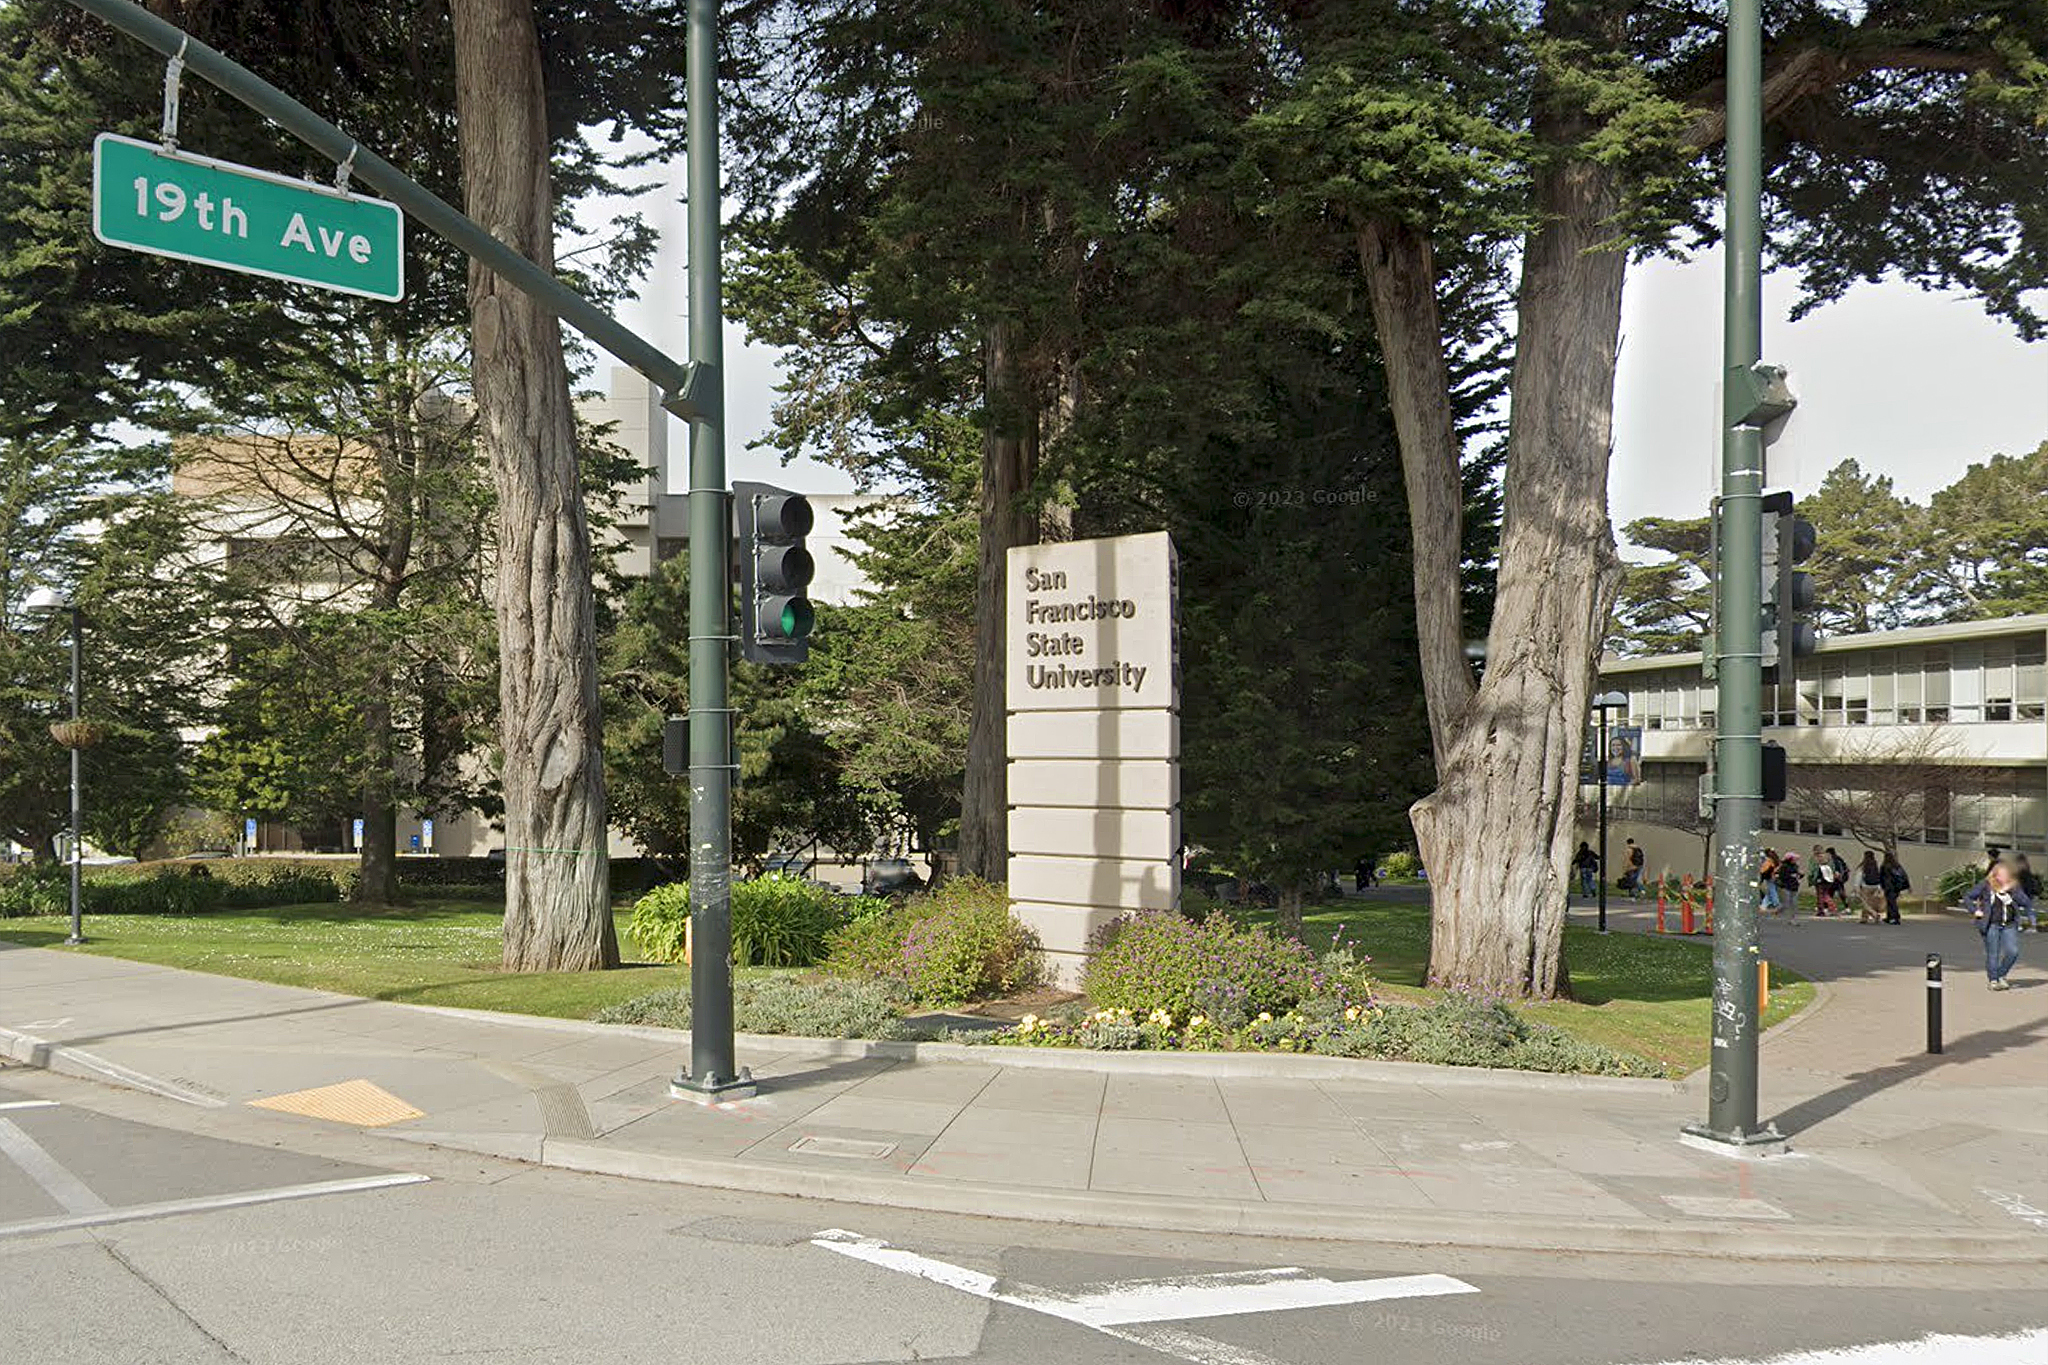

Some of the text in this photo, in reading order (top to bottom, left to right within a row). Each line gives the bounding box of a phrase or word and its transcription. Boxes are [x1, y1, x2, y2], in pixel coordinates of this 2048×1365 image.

[134, 177, 372, 264] 19th Ave
[1026, 567, 1067, 592] San
[1026, 595, 1136, 624] Francisco
[1026, 632, 1084, 657] State
[1026, 660, 1147, 693] University
